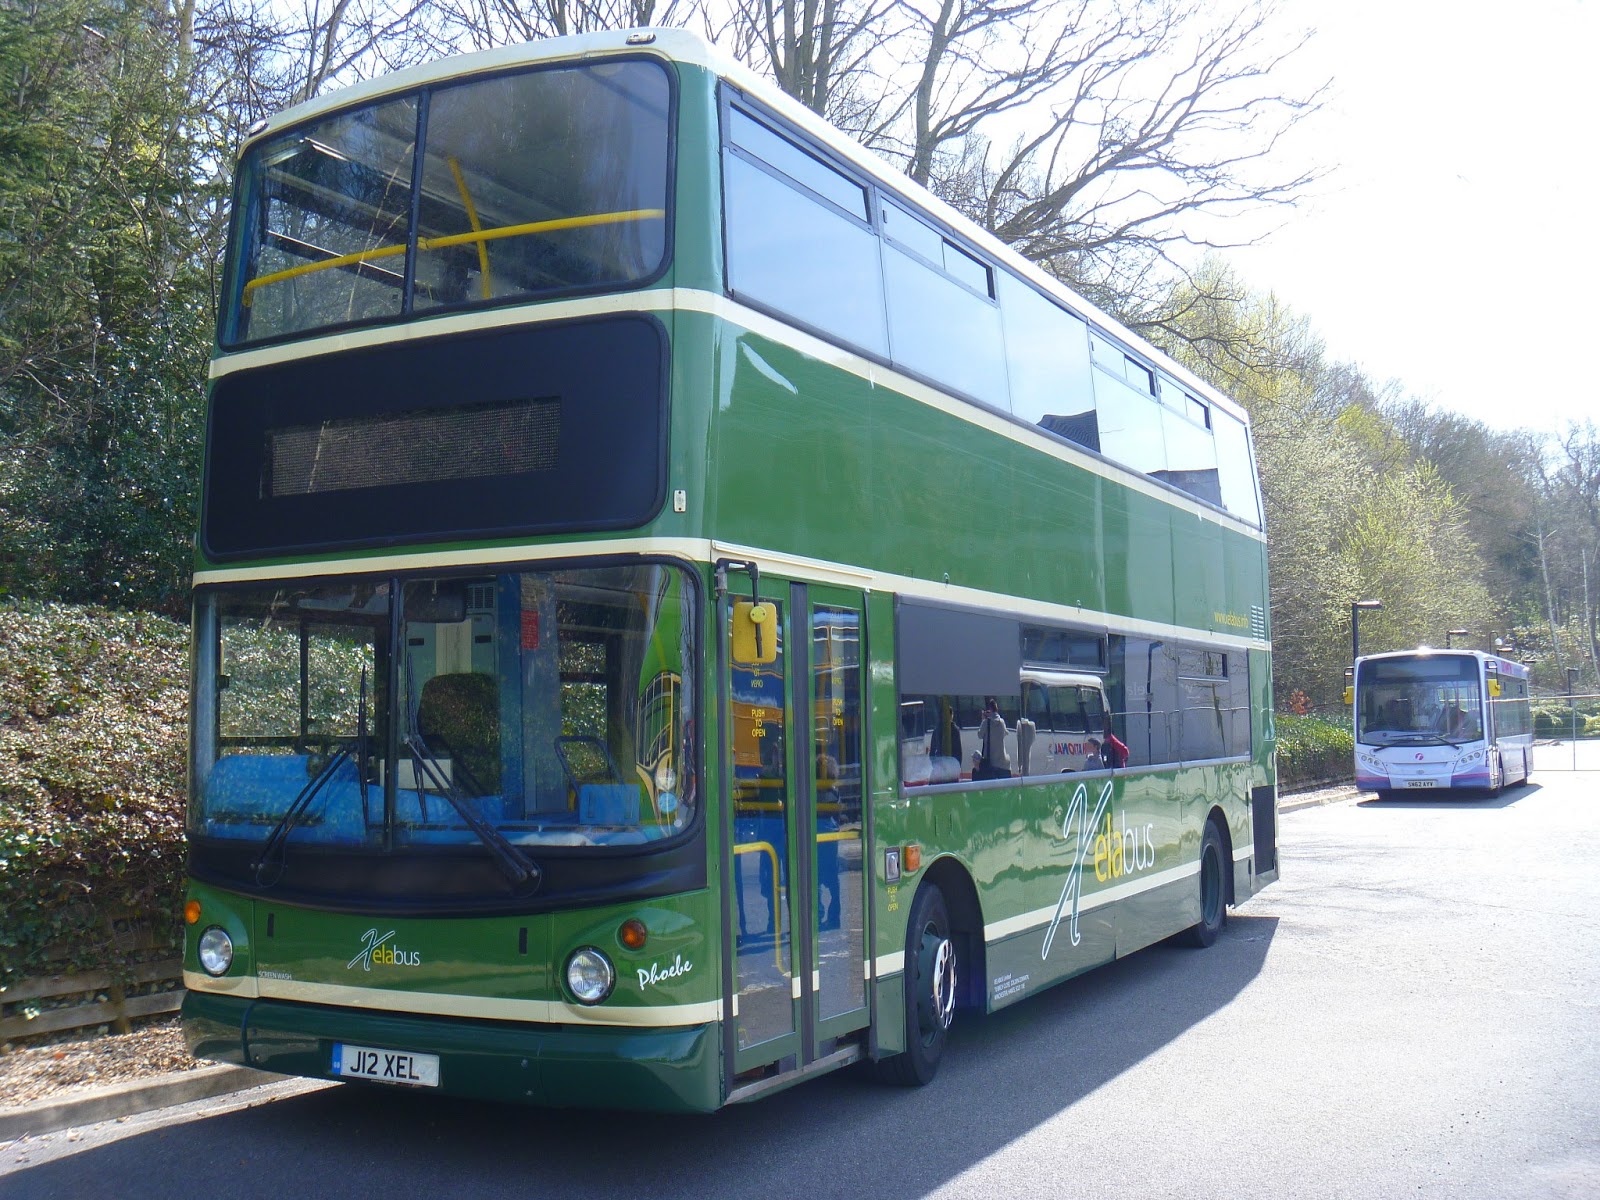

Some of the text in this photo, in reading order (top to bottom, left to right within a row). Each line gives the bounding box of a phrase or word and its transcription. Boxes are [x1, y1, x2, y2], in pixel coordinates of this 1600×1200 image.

[751, 709, 766, 717] PUSH
[755, 719, 763, 727] TO
[832, 717, 844, 726] OPEN
[751, 728, 766, 737] OPEN
[1042, 780, 1156, 960] Xelabus
[347, 928, 421, 972] Xelabus
[277, 972, 292, 980] WASH
[636, 954, 693, 991] Phoebe
[350, 1051, 419, 1080] J12 XEL
